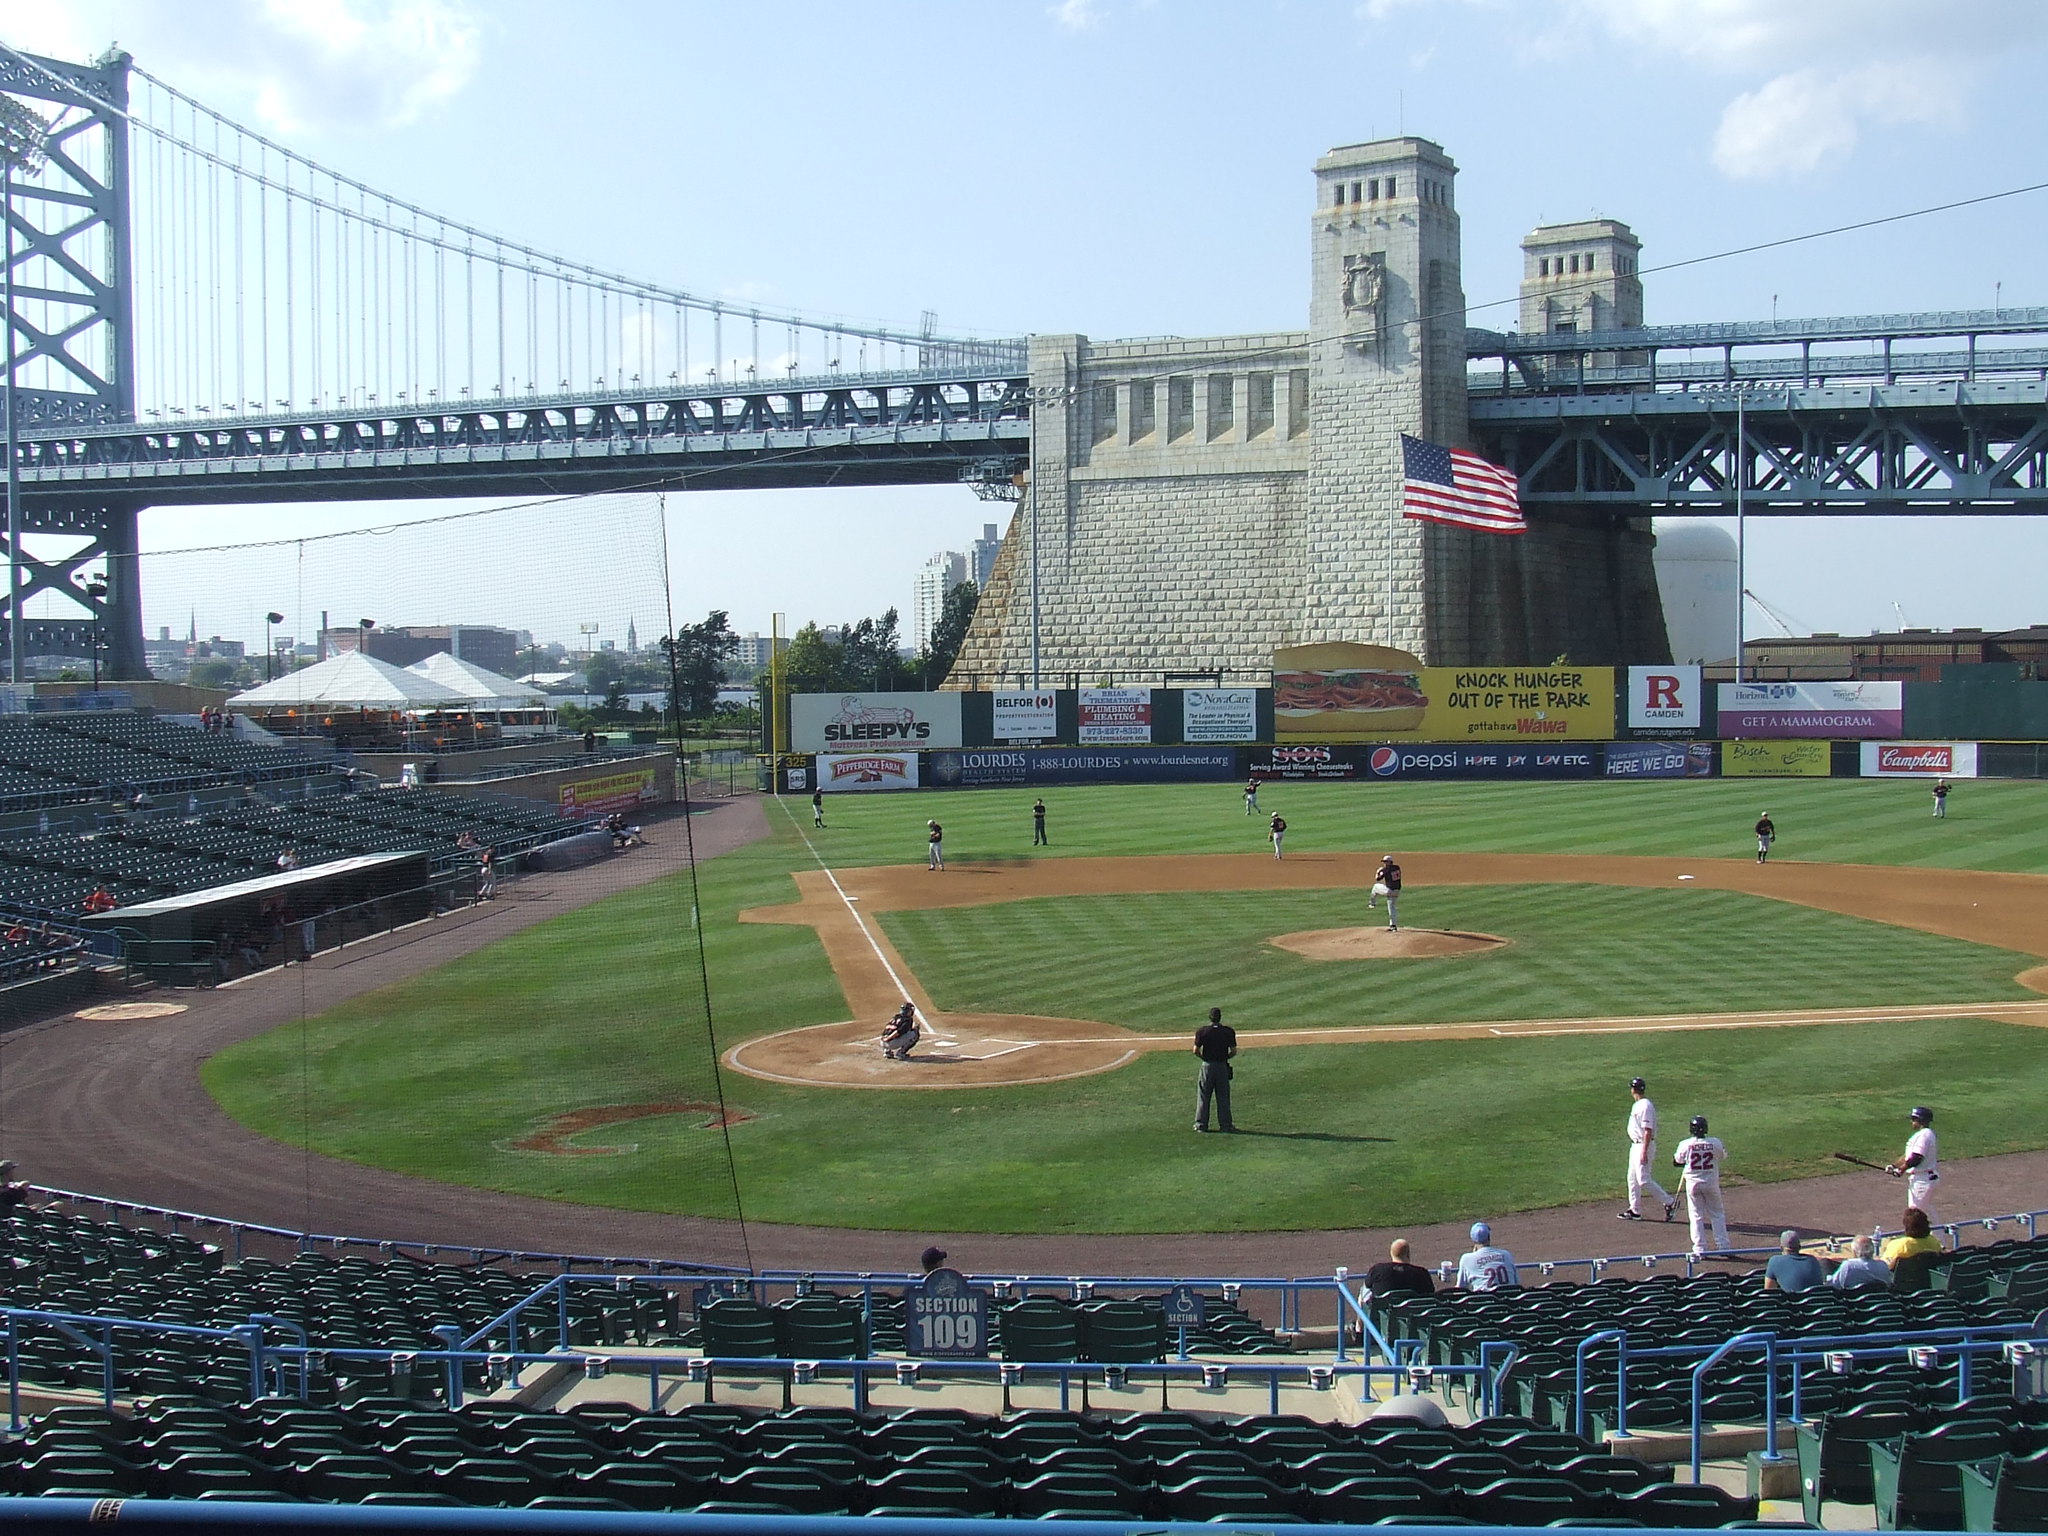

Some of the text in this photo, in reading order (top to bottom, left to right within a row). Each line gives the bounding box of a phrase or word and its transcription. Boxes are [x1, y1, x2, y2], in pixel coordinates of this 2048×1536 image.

[1456, 672, 1582, 689] KNOCK HUNGER
[1204, 693, 1250, 704] NovaCare
[1646, 675, 1683, 708] R
[1735, 691, 1769, 700] Horizon
[996, 698, 1033, 707] BELFOR
[1448, 692, 1590, 708] OUT OF THE PARK
[1084, 705, 1145, 713] PLUMBING &
[1645, 711, 1684, 719] CAMDEN
[1468, 718, 1568, 734] gottahava Wawa
[1742, 715, 1876, 727] GET A MAMMOGRAM.
[824, 721, 930, 741] SLEEPY'S
[829, 739, 925, 749] Mattress Professionals
[1729, 743, 1770, 759] Busch
[785, 757, 807, 767] 325
[962, 753, 1026, 768] LOURDES
[1032, 755, 1229, 770] 1-888-LOURDES www.lourdesnet.org
[1272, 746, 1331, 763] SOS
[1402, 751, 1457, 770] pepsi
[1465, 755, 1497, 765] HOPE
[1882, 749, 1948, 770] Campbell's
[837, 760, 901, 774] PEPPERIDGE FARM
[1250, 762, 1354, 772] Serving Award Winning Cheesesteaks
[1606, 755, 1685, 775] HERE WE GO
[1690, 1152, 1714, 1170] 22
[1484, 1265, 1509, 1288] 20
[915, 1297, 978, 1313] SECTION
[1168, 1313, 1198, 1322] SECTION
[917, 1314, 977, 1349] 109
